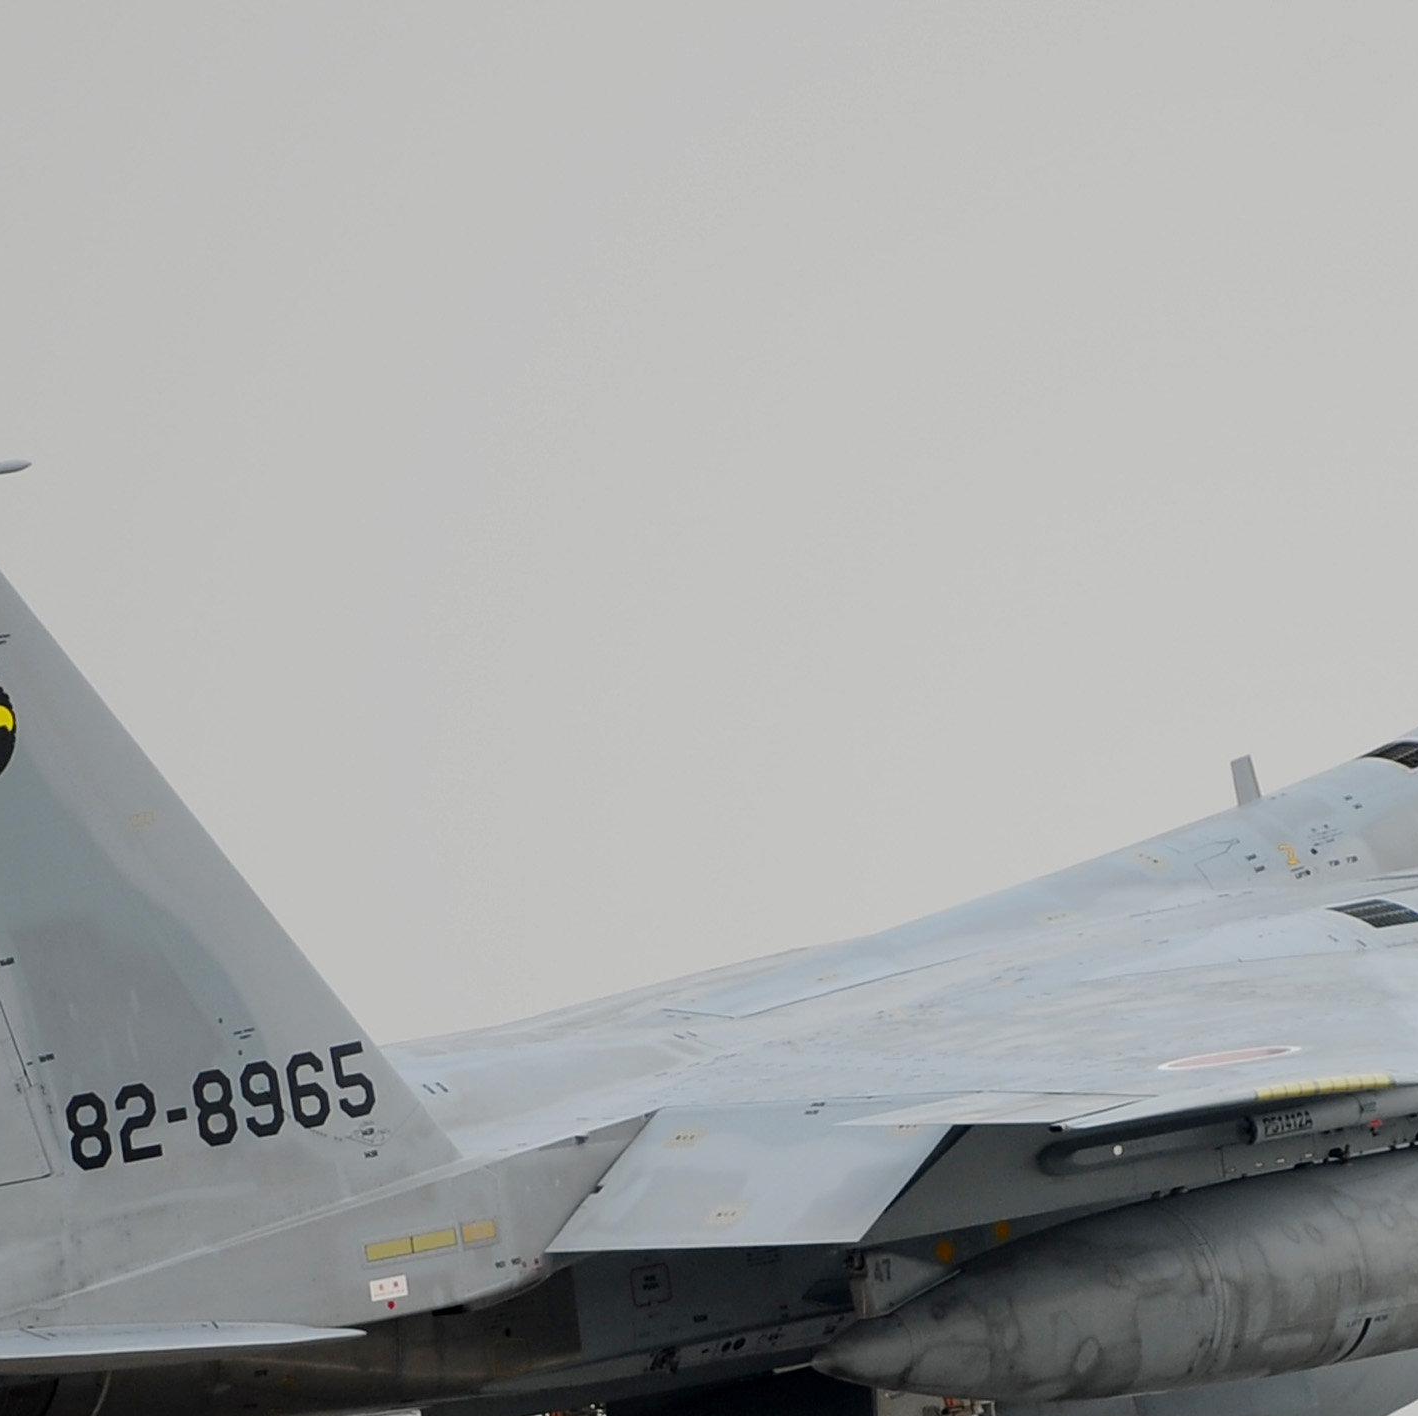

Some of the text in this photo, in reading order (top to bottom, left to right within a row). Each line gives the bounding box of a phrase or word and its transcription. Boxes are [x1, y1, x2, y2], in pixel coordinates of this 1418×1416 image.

[65, 1040, 377, 1171] 82-8965
[1263, 1110, 1314, 1134] P51412A
[874, 1258, 892, 1283] 47
